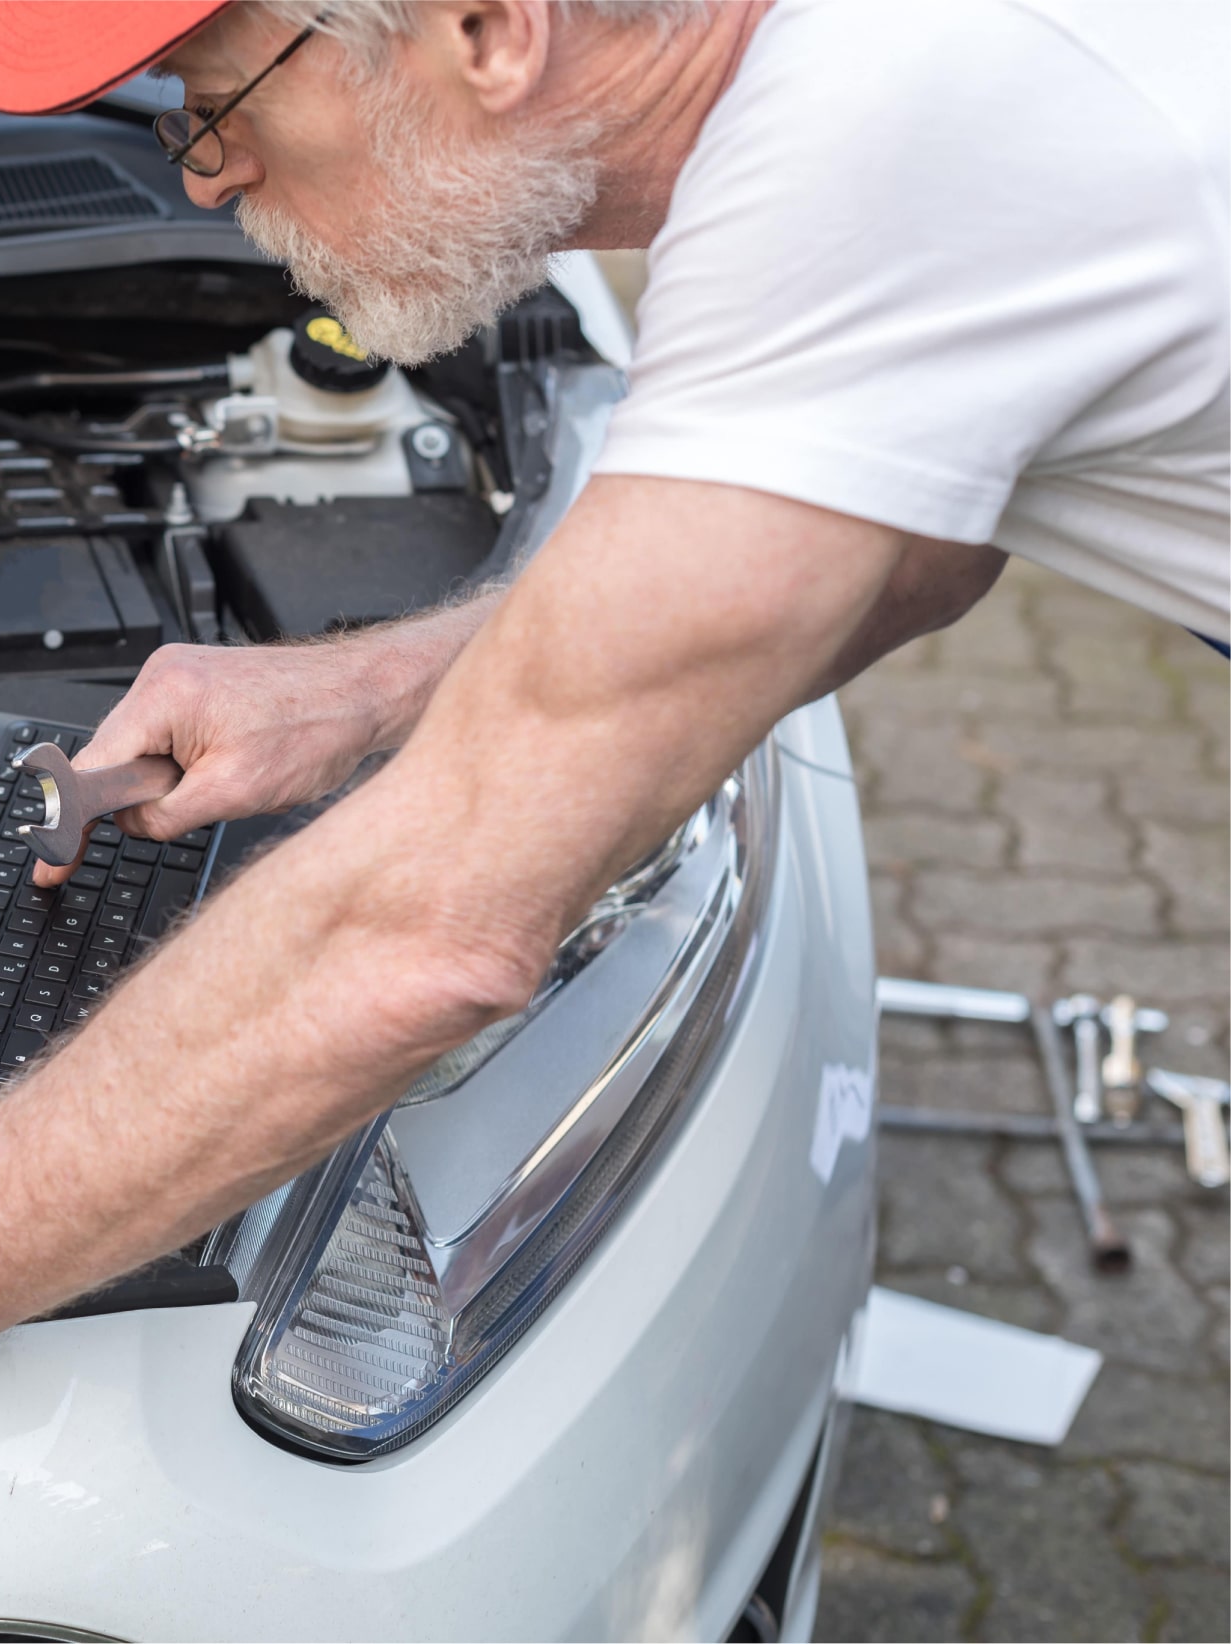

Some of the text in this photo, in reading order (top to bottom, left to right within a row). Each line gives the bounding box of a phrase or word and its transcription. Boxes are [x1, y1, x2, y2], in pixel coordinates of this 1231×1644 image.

[30, 1014, 42, 1022] Q
[66, 918, 77, 926] G
[77, 1008, 89, 1017] W
[87, 984, 99, 992] X
[96, 960, 107, 968] C
[121, 891, 132, 899] N
